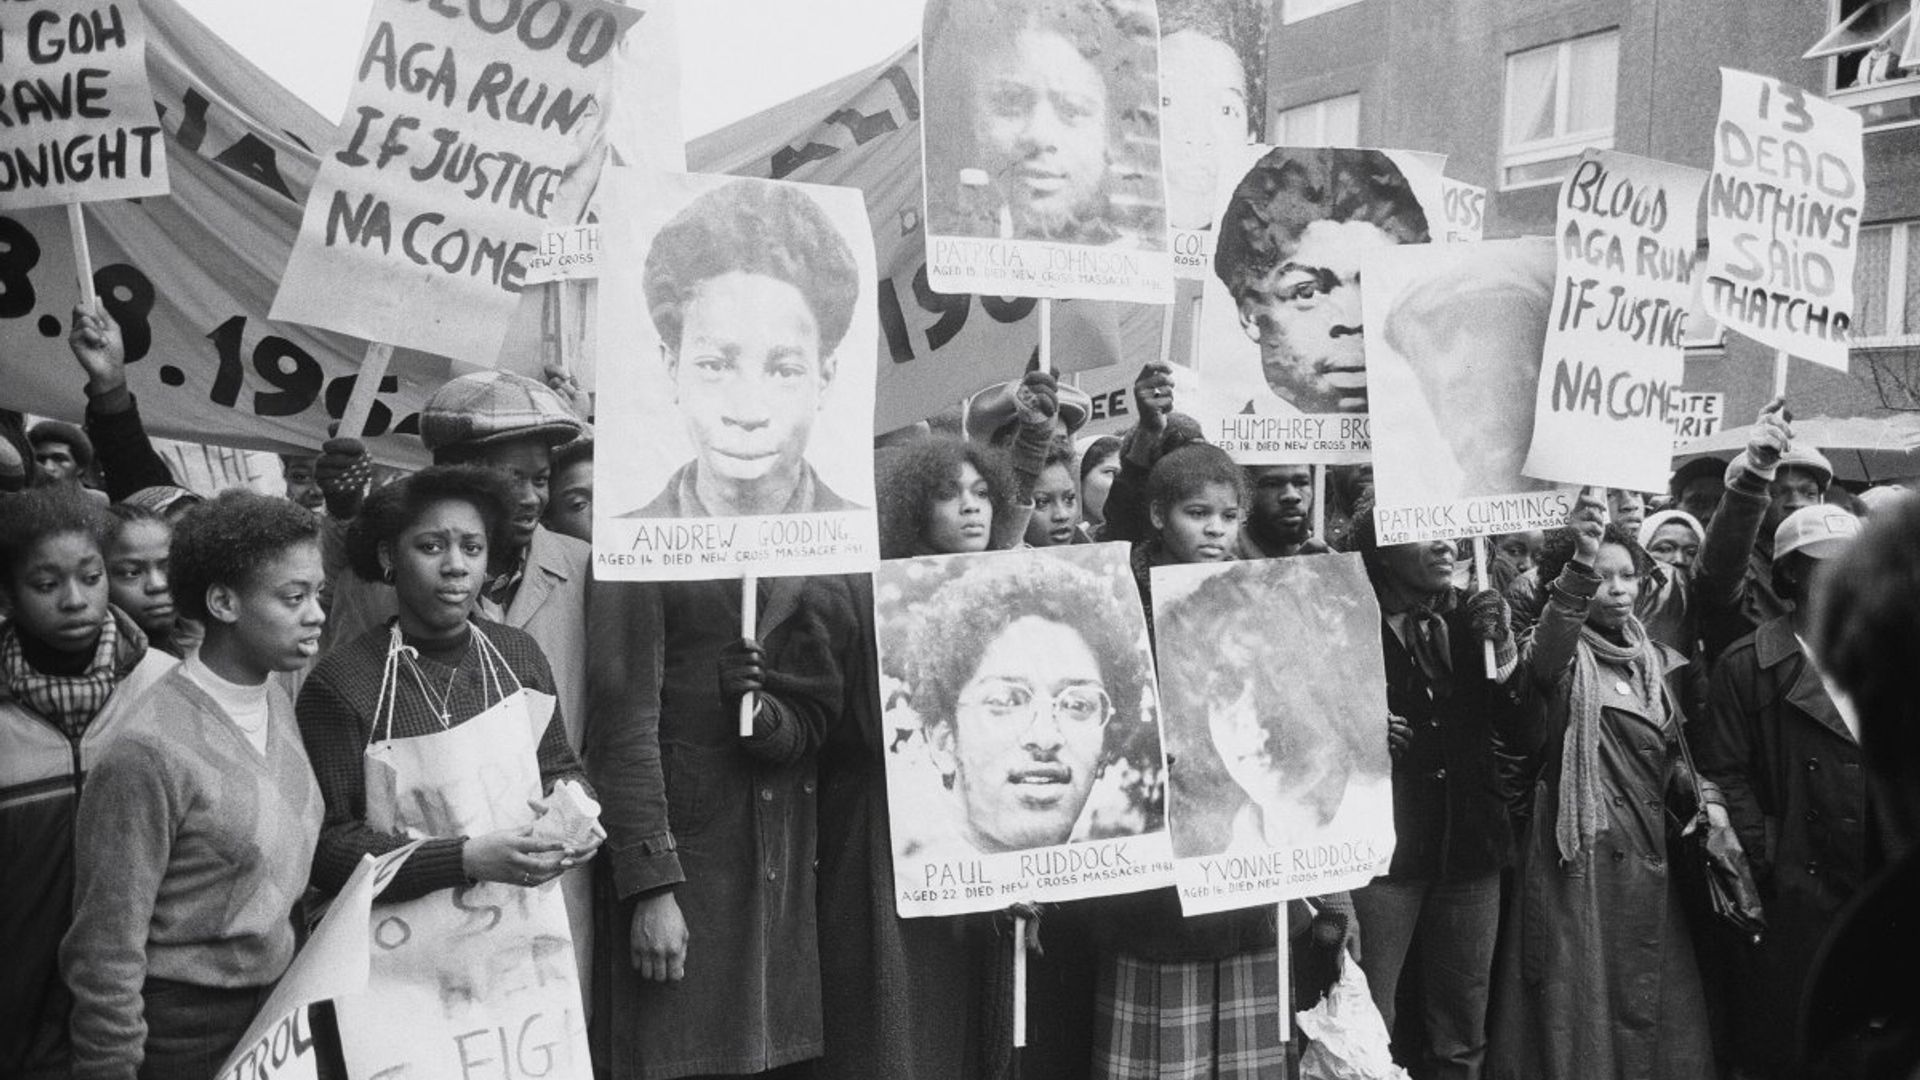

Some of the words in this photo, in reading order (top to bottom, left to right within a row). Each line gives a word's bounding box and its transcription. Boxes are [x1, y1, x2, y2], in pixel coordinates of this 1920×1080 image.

[358, 21, 457, 108] AGA
[467, 61, 598, 135] RUN
[1759, 81, 1815, 133] 13
[335, 105, 421, 170] IF
[1720, 120, 1857, 200] DEAD
[1567, 160, 1668, 234] BLOOD
[325, 189, 391, 255] NA
[402, 212, 538, 294] COME
[558, 253, 594, 266] CROSS
[1040, 245, 1138, 275] JOHNSON
[1563, 219, 1627, 274] AGA
[1636, 235, 1698, 285] RUN
[1558, 276, 1600, 331] IF
[1552, 357, 1602, 416] NA
[1222, 418, 1325, 440] HUMPHREY
[1257, 441, 1280, 451] DIED
[1285, 441, 1308, 451] NEW
[1313, 441, 1346, 451] CROSS
[631, 523, 738, 551] ANDREW
[758, 518, 848, 547] GOODING
[1379, 503, 1457, 532] PATRICK
[1467, 495, 1570, 525] CUMMINGS
[1382, 532, 1410, 543] AGED
[1432, 528, 1455, 538] DIED
[1460, 526, 1484, 537] NEW
[1489, 522, 1523, 535] CROSS
[598, 553, 635, 566] AGED
[663, 553, 692, 566] DIED
[701, 552, 727, 564] NEW
[735, 550, 769, 562] CROSS
[775, 544, 836, 560] MASSACRE
[902, 889, 938, 901] AGED
[942, 888, 957, 900] 22
[965, 885, 994, 899] DIED
[1002, 879, 1029, 895] NEW
[1037, 874, 1078, 888] CROSS
[1083, 863, 1147, 882] MASSACRE
[925, 860, 992, 887] PAUL
[1020, 843, 1131, 878] RUDDOCK
[1199, 851, 1283, 884] YVONNE
[1293, 838, 1375, 871] RUDDOCK
[1183, 887, 1210, 898] AGED
[1229, 881, 1254, 893] DIED
[1258, 877, 1280, 889] NEW
